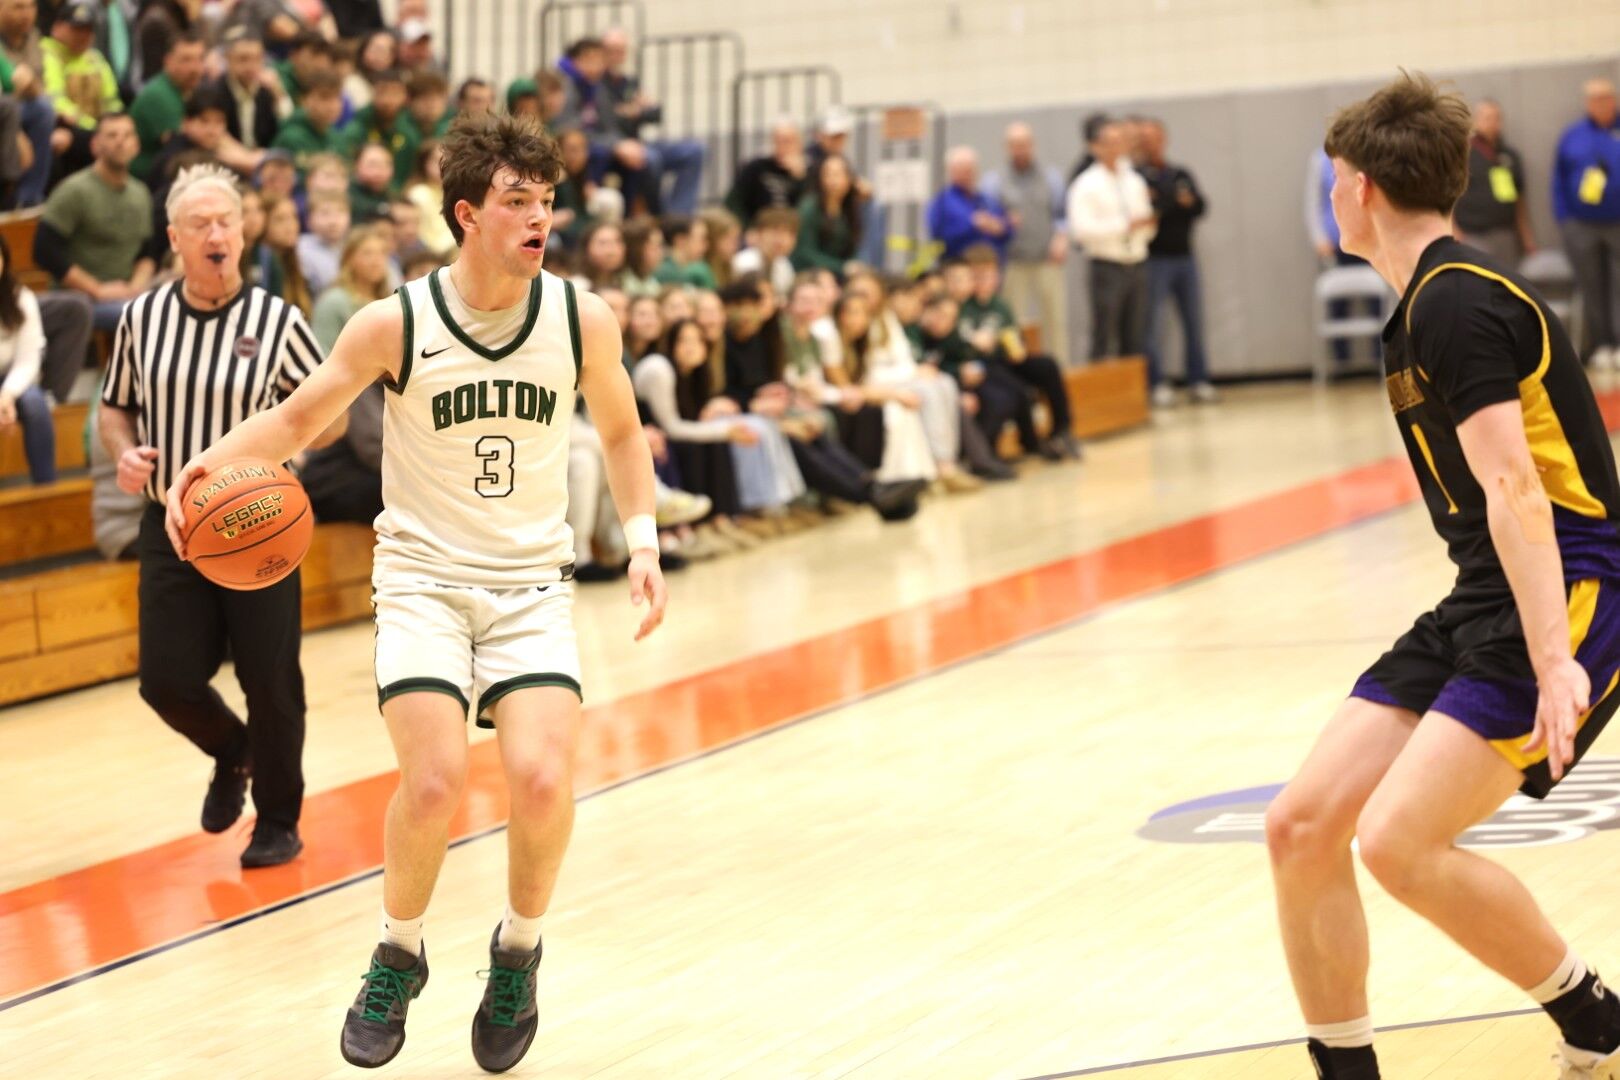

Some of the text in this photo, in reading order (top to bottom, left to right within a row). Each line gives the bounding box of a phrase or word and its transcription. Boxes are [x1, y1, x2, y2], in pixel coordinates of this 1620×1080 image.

[432, 380, 557, 431] BOLTON
[192, 465, 277, 514] SPALDING
[475, 436, 514, 498] 3
[212, 492, 282, 533] LEGACY
[240, 507, 282, 531] 1000
